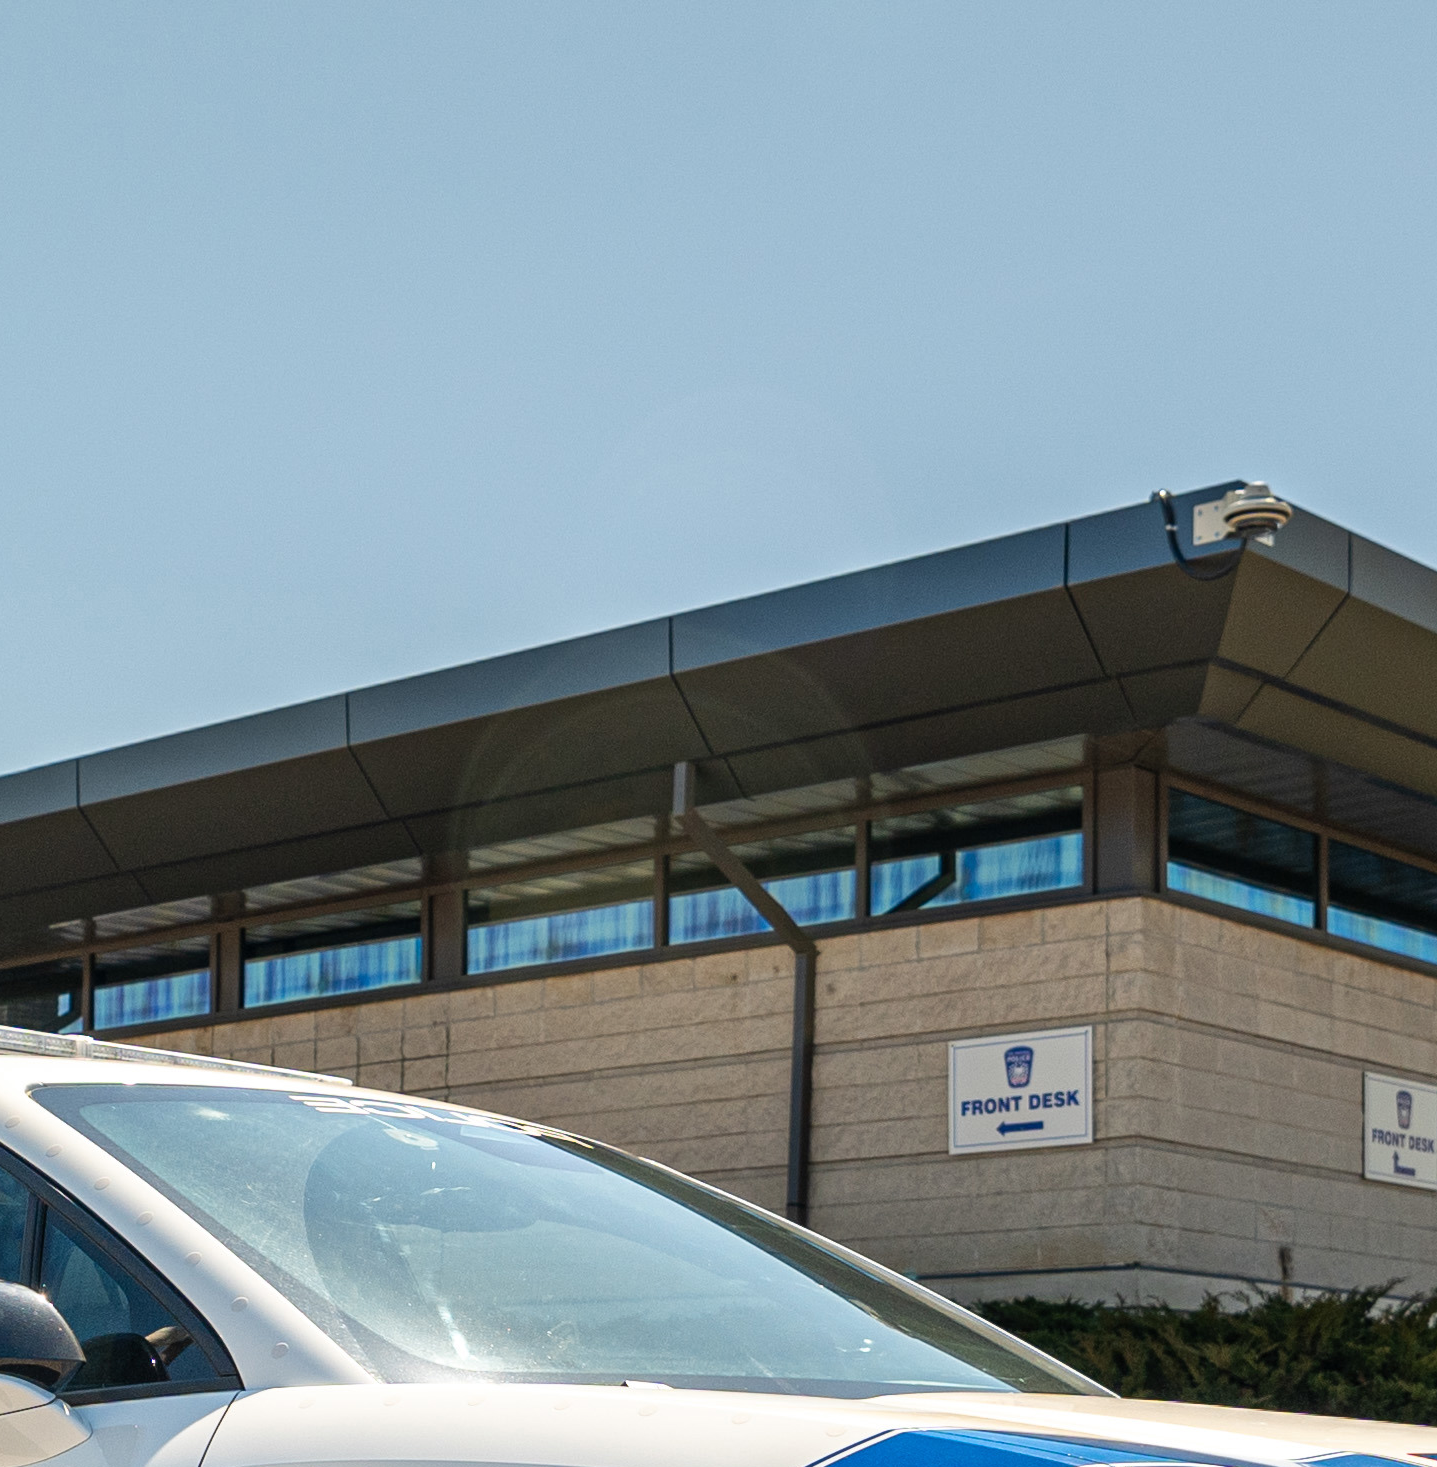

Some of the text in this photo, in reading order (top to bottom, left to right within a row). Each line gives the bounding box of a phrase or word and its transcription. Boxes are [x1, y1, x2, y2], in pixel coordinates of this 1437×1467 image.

[961, 1090, 1079, 1116] FRONT DESK
[1371, 1128, 1435, 1154] FRONT DESK
